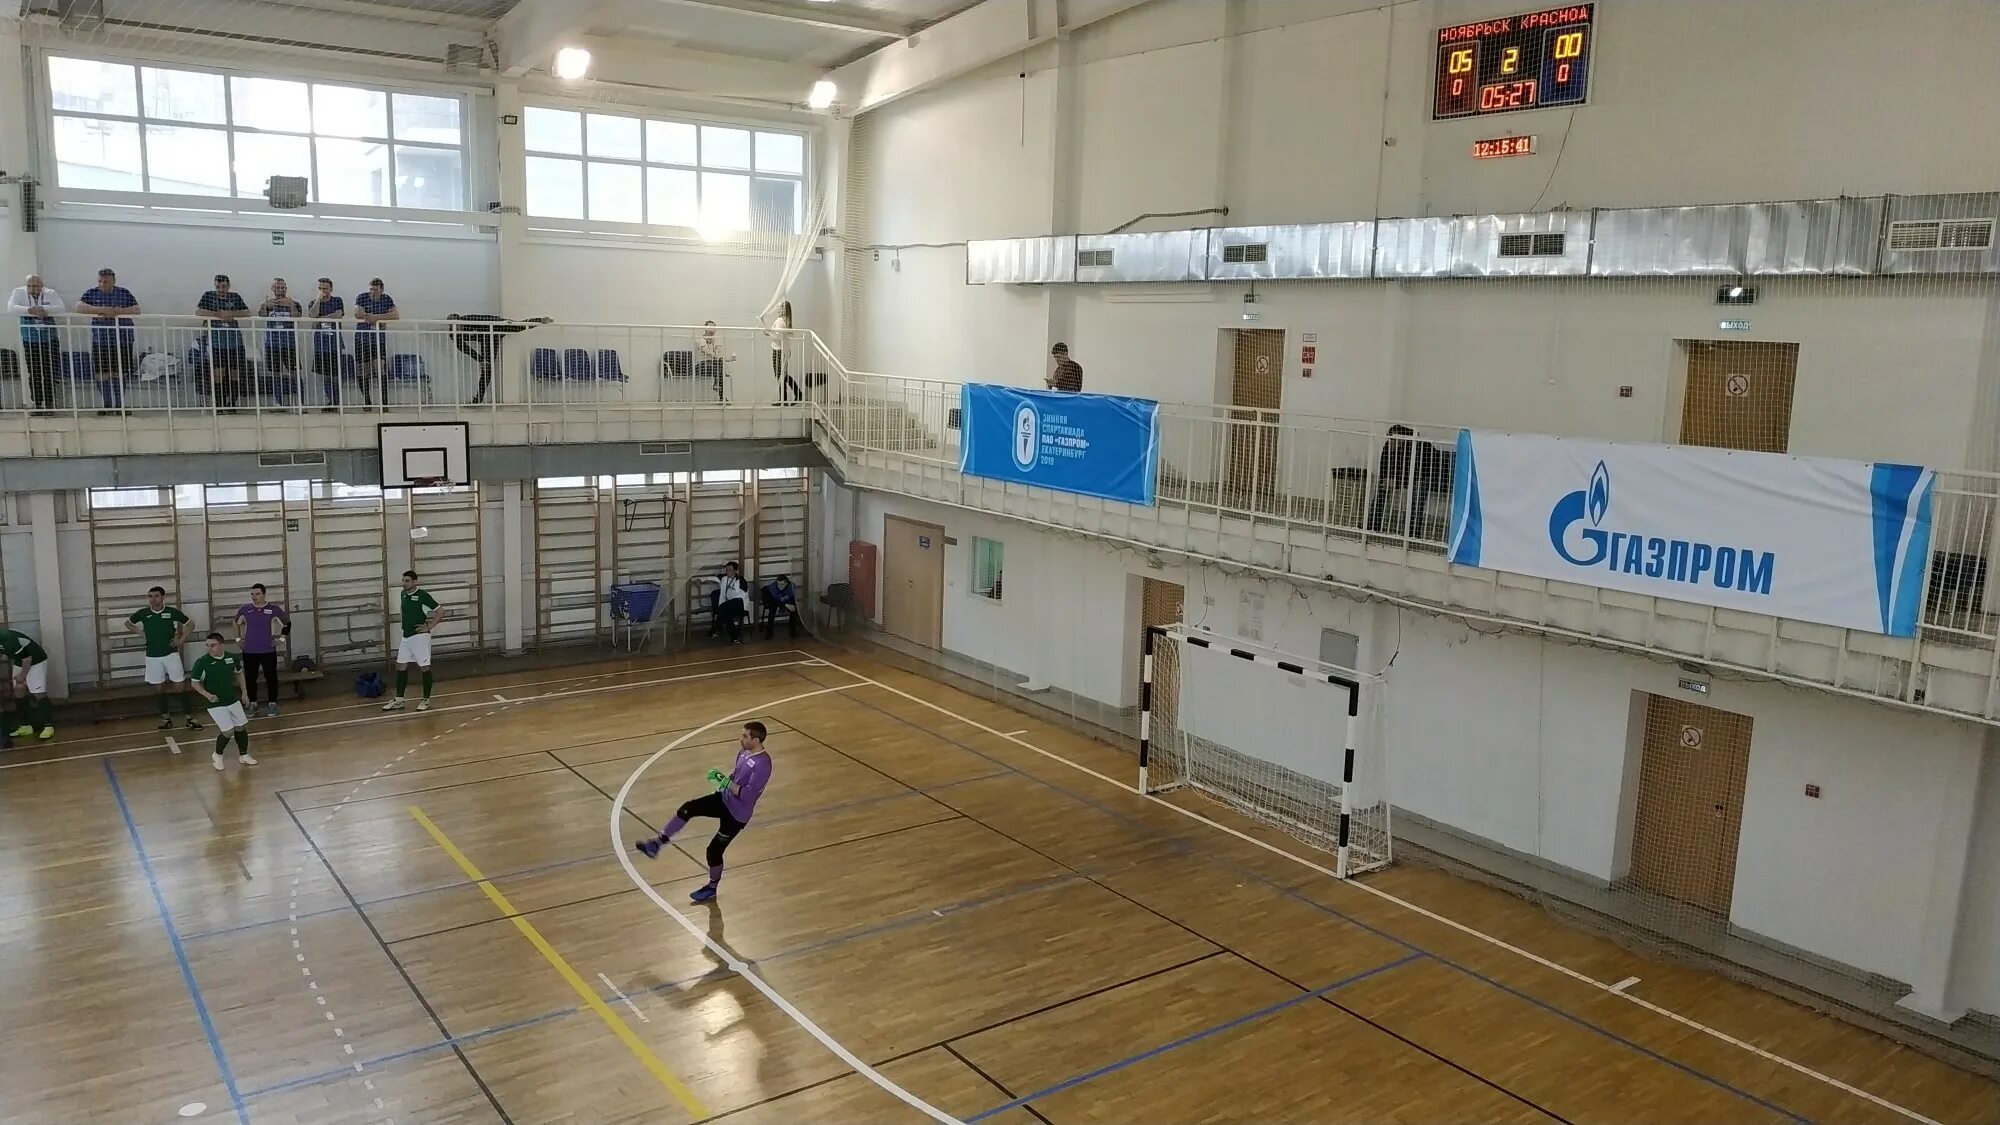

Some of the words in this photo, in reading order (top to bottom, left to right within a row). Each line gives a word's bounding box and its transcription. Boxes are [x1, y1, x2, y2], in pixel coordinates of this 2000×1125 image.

[1440, 19, 1511, 41] НОЯБРЬСК
[1520, 6, 1588, 29] КРАСНОД
[1555, 32, 1582, 59] 00
[1449, 49, 1472, 74] 05
[1503, 49, 1518, 72] 2
[1557, 64, 1569, 82] 0
[1452, 79, 1463, 95] 0
[1481, 82, 1535, 109] 05:27
[1474, 138, 1530, 157] 12:15:41
[1720, 320, 1749, 330] ВЫХОД
[1042, 413, 1067, 424] ЗИМНЯЯ
[1042, 424, 1085, 438] СПАРТАКИАДА
[1042, 434, 1054, 444] ПАО
[1041, 445, 1086, 459] ЕКАТЕРИНБУРГ
[1609, 532, 1775, 595] ГАЗПРОМ
